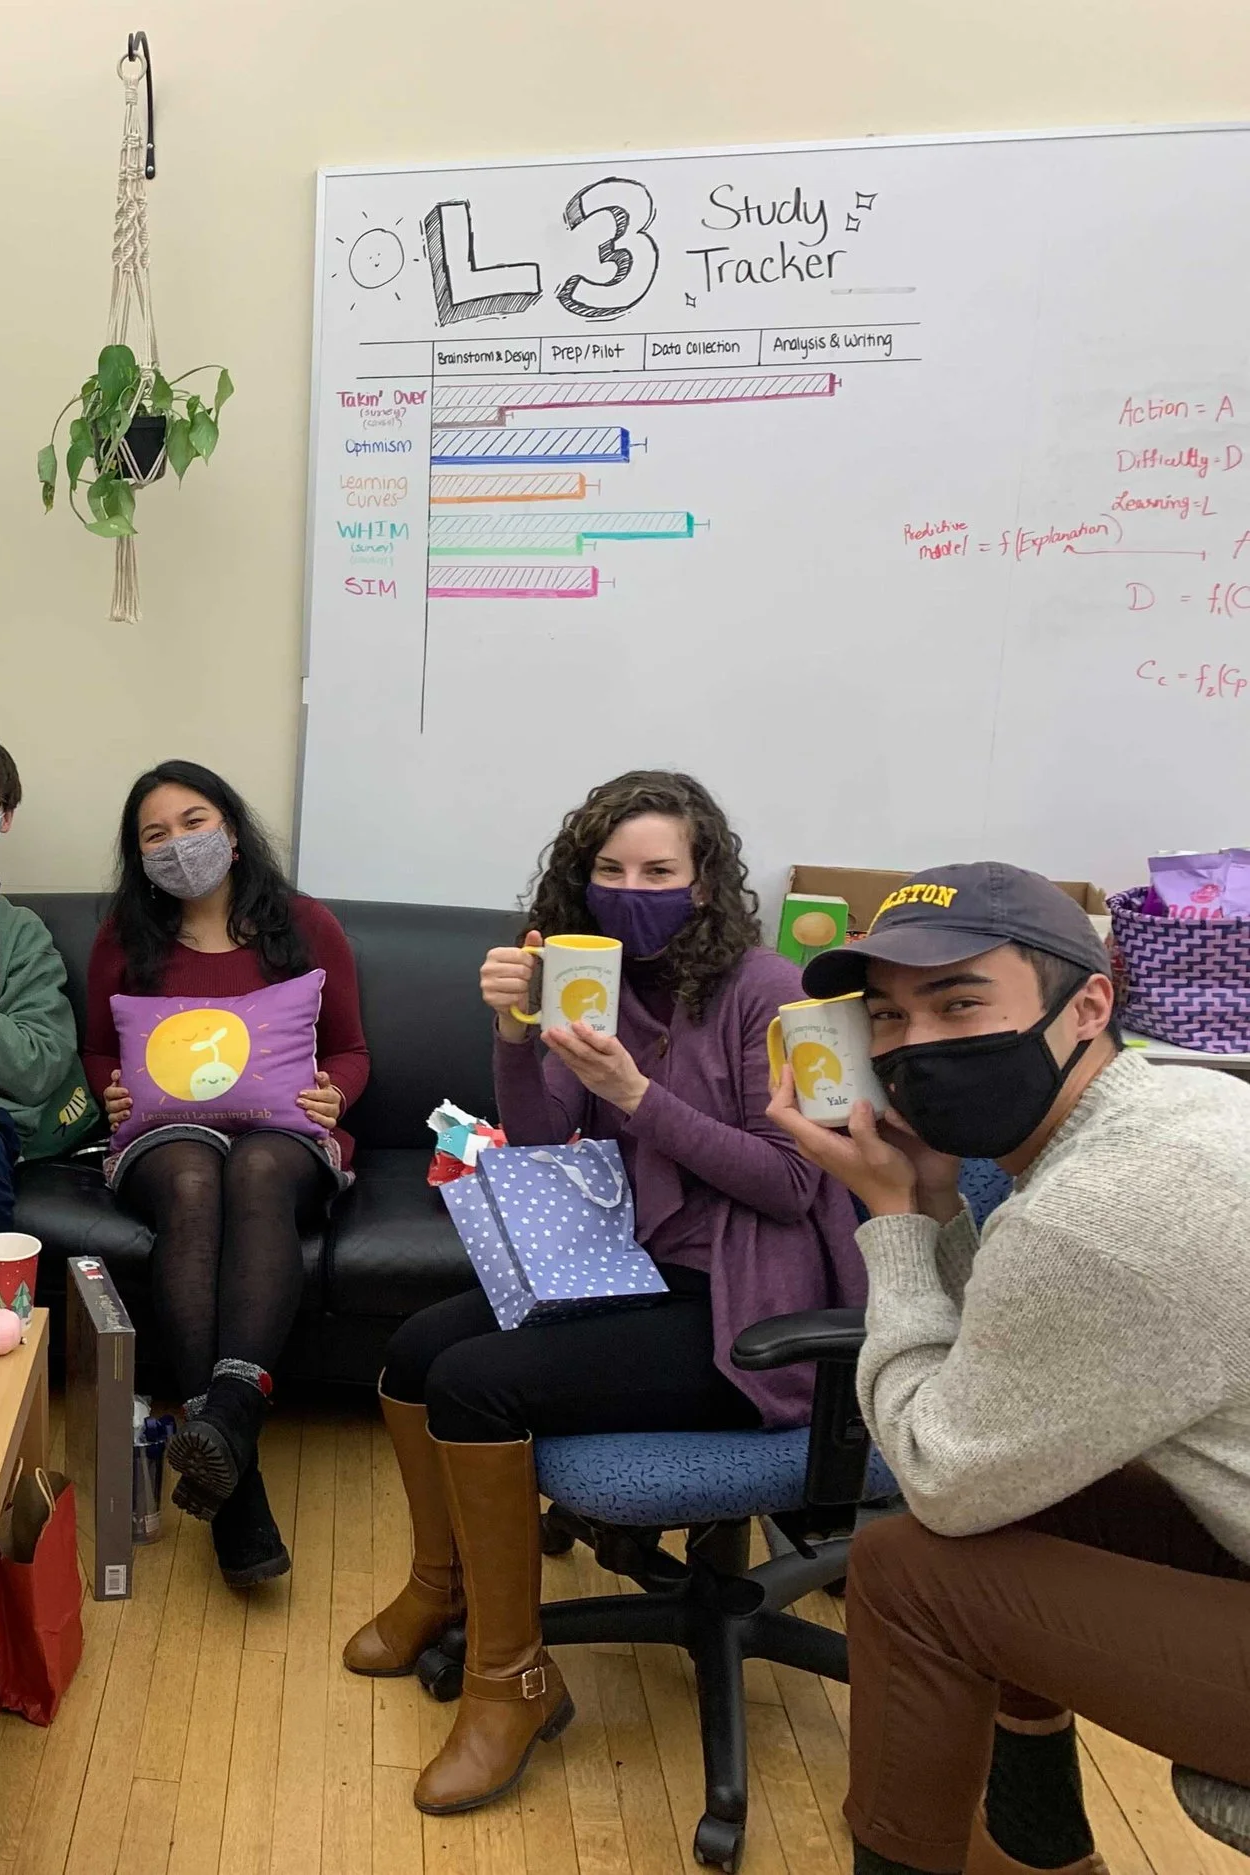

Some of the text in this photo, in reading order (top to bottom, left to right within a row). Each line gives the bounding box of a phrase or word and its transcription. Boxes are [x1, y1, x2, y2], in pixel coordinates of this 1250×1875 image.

[700, 183, 828, 247] Study
[686, 242, 847, 292] Tracker
[651, 341, 681, 357] Data
[773, 332, 893, 359] Analysis & Writing
[437, 351, 495, 365] Brainstorm
[504, 350, 537, 371] Design
[336, 389, 428, 408] Takin' Over
[1118, 396, 1189, 427] Action
[1214, 395, 1235, 422] A
[345, 438, 412, 457] Optimism
[339, 474, 408, 500] Learning
[346, 490, 400, 509] Curves
[1111, 490, 1190, 520] Learning
[336, 520, 410, 541] WHIM
[344, 576, 398, 599] SIM
[1125, 582, 1156, 611] D
[879, 883, 958, 912] LETON
[826, 1095, 849, 1106] Yale
[141, 1107, 273, 1122] Leonard Learning Lab
